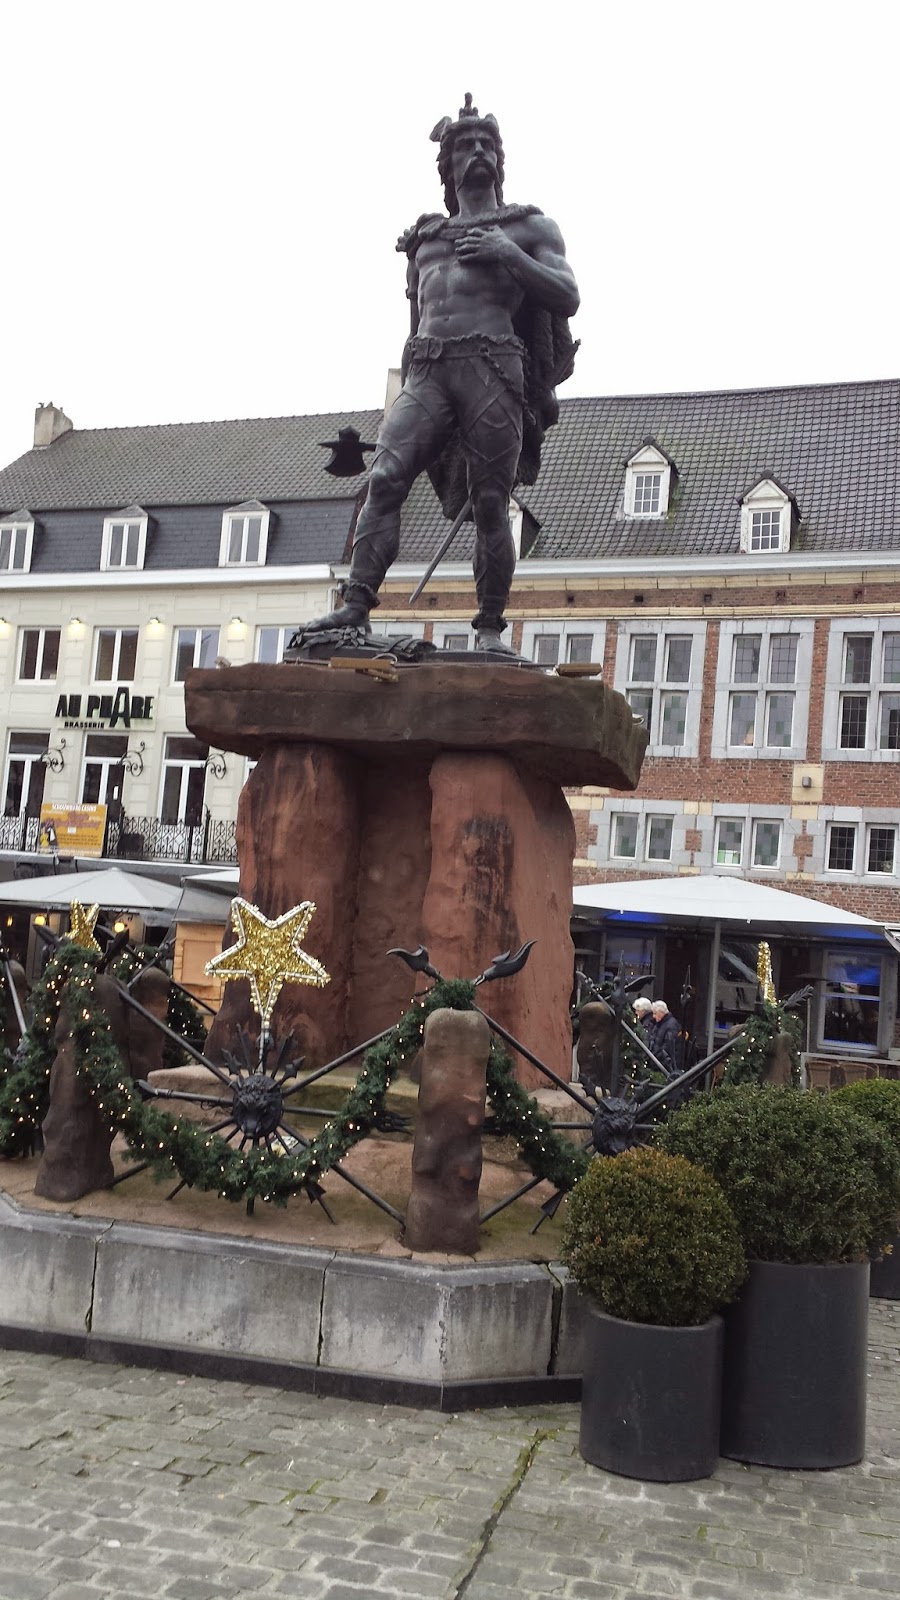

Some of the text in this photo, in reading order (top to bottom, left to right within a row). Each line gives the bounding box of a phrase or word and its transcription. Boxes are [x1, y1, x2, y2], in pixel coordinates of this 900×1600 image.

[55, 687, 155, 728] AU PHARE
[64, 721, 105, 729] BRASSERIE
